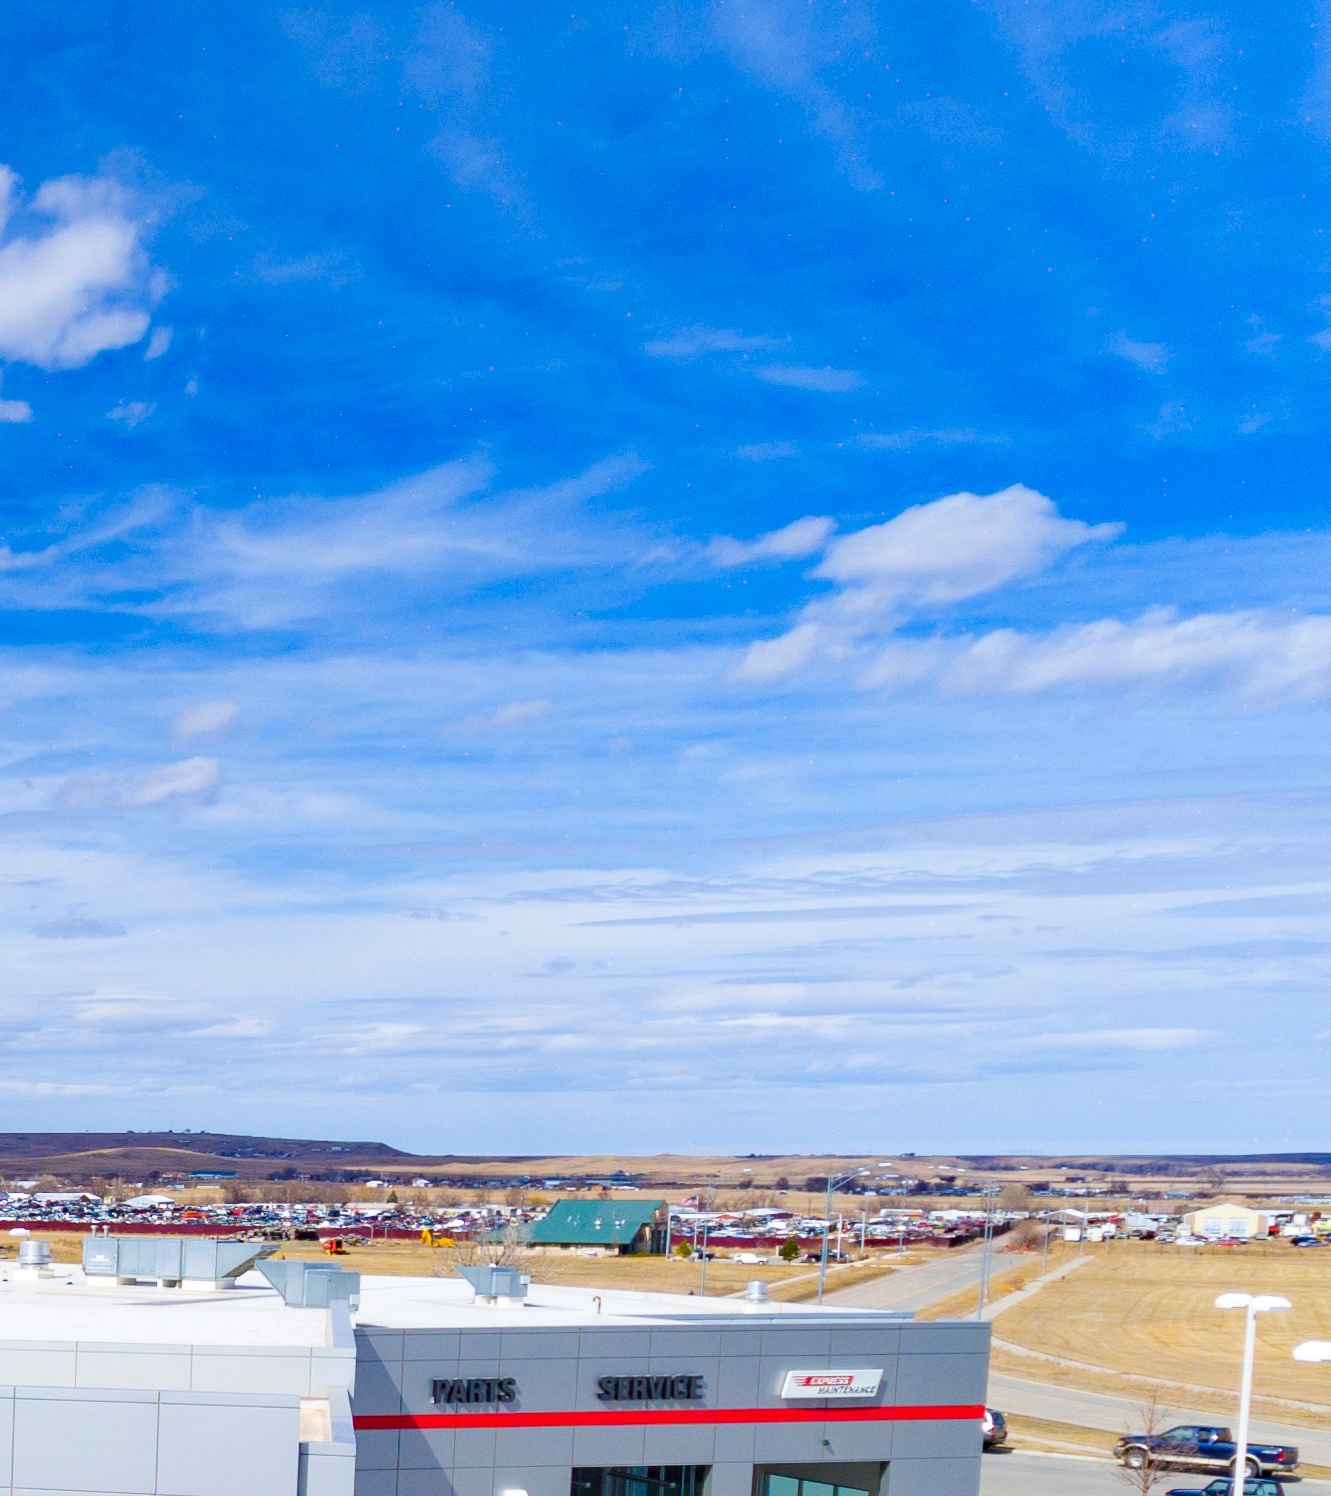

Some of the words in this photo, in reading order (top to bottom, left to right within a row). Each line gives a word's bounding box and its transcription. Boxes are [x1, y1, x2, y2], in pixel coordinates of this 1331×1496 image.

[432, 1377, 517, 1404] PARTS
[596, 1375, 705, 1401] SERVICE
[817, 1385, 876, 1394] MAINTENANCE
